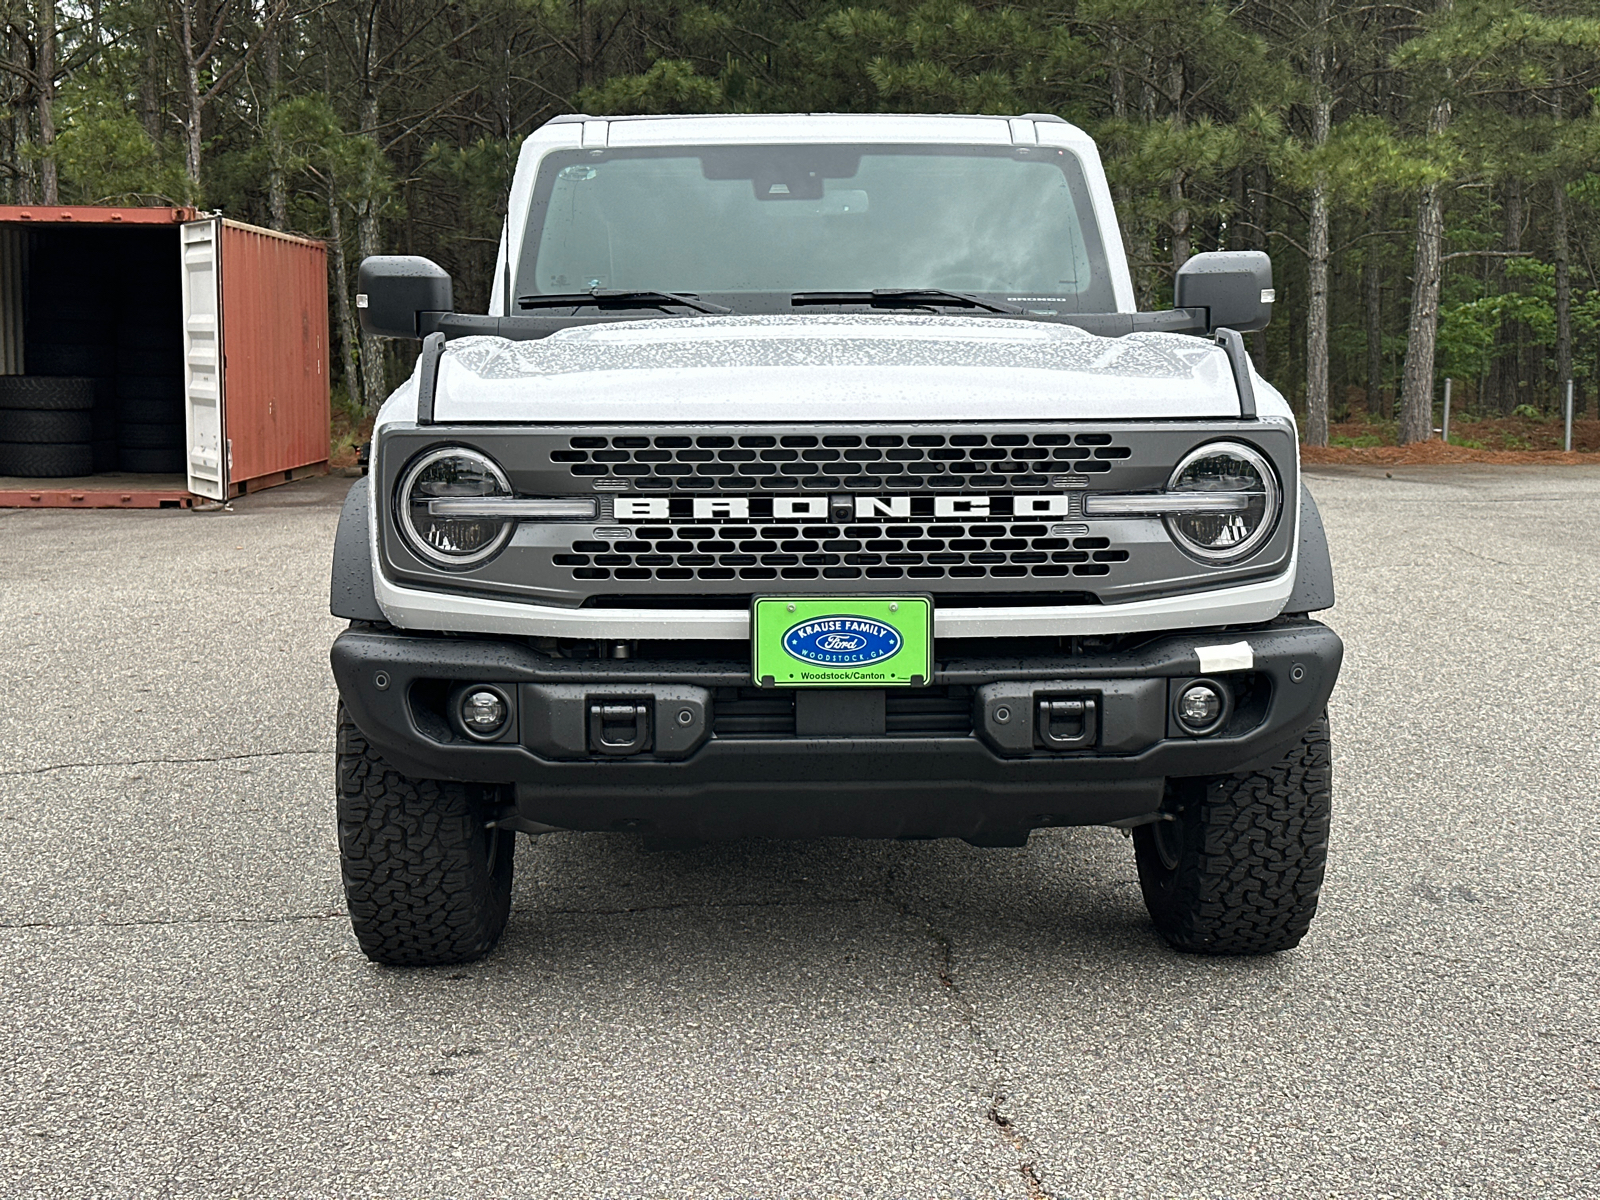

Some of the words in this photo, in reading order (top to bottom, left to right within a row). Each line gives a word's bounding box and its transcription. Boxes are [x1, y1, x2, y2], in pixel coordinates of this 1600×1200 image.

[613, 495, 1068, 519] BRONCO
[798, 621, 842, 638] KRAUSE
[845, 621, 887, 638] FAMILY
[824, 635, 857, 649] Ford
[870, 649, 885, 658] GA
[801, 671, 885, 680] Woodstock/Canton
